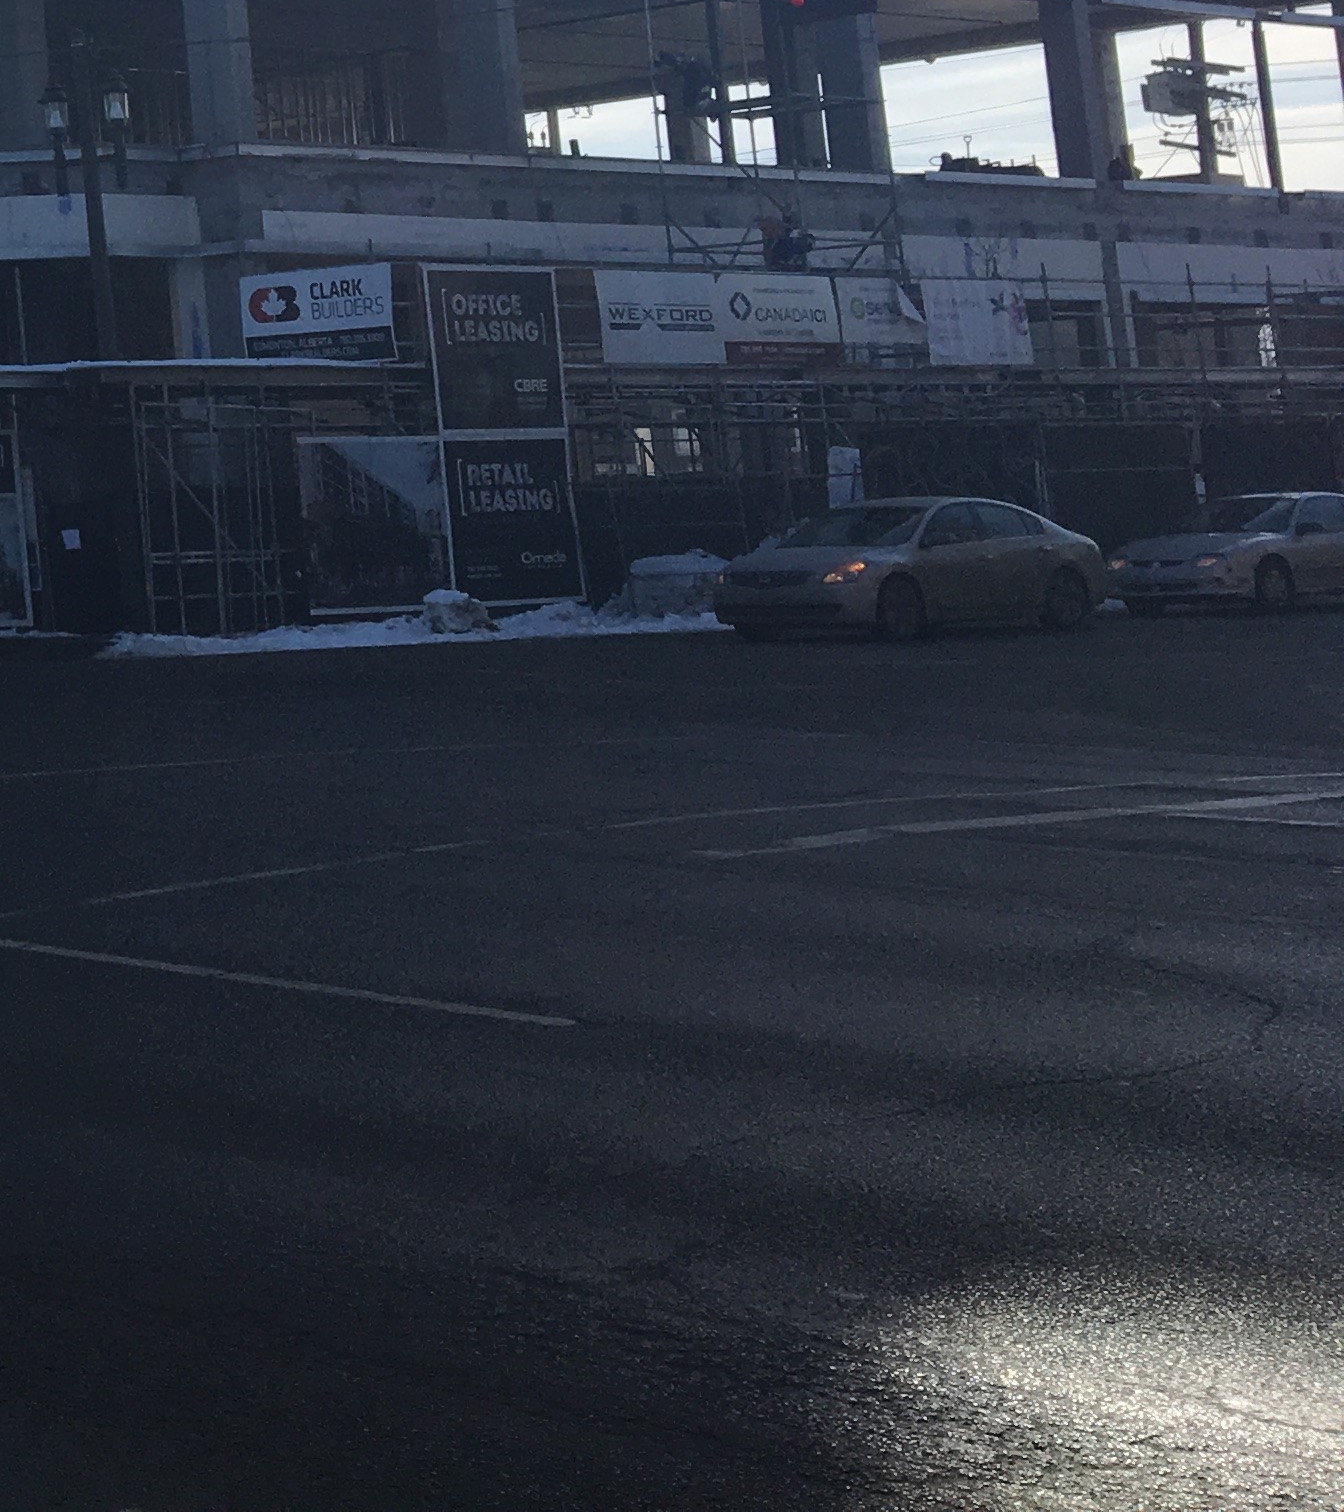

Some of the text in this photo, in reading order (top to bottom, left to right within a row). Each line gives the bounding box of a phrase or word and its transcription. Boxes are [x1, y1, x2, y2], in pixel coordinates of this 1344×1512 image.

[310, 279, 362, 300] CLARK
[312, 296, 385, 320] BUILDERS
[451, 293, 522, 316] OFFICE
[608, 307, 713, 322] WEXFORD
[454, 320, 539, 342] LEASING
[514, 378, 549, 392] CBRE
[467, 462, 534, 486] RETAIL
[469, 489, 554, 513] LEASING
